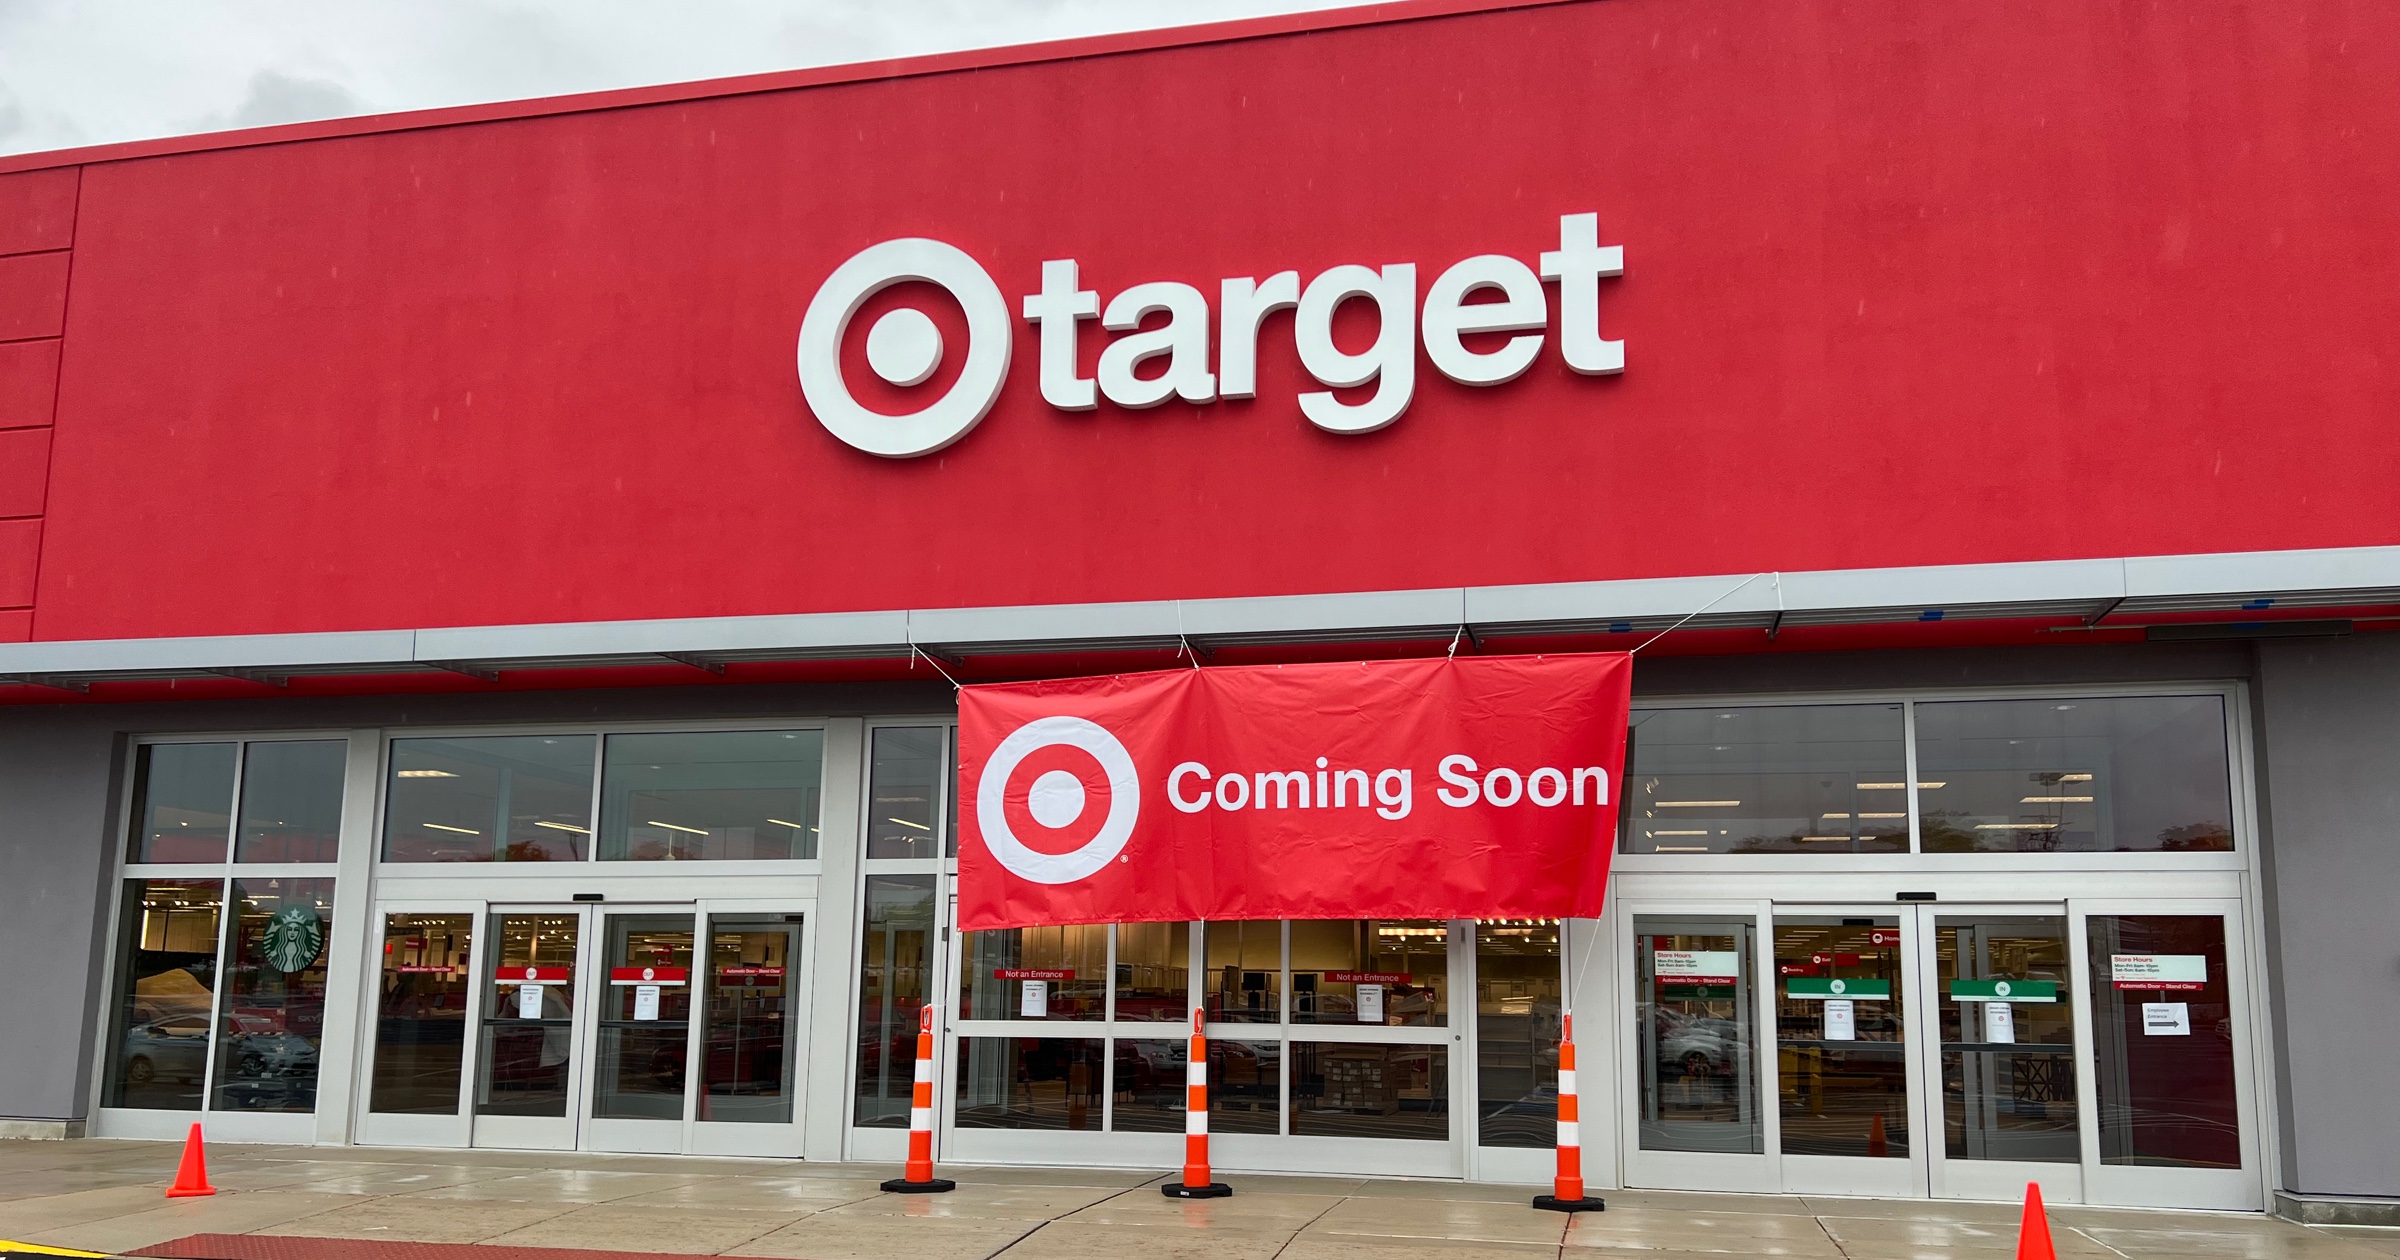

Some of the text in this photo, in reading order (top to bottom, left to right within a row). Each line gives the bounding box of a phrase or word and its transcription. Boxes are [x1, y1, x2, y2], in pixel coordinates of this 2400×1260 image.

[1023, 212, 1624, 435] target
[1167, 754, 1608, 820] Coming Soon
[1005, 970, 1019, 978] Not
[1031, 970, 1063, 978] Entrance
[1336, 973, 1350, 981] Not
[1364, 973, 1399, 982] Entrance
